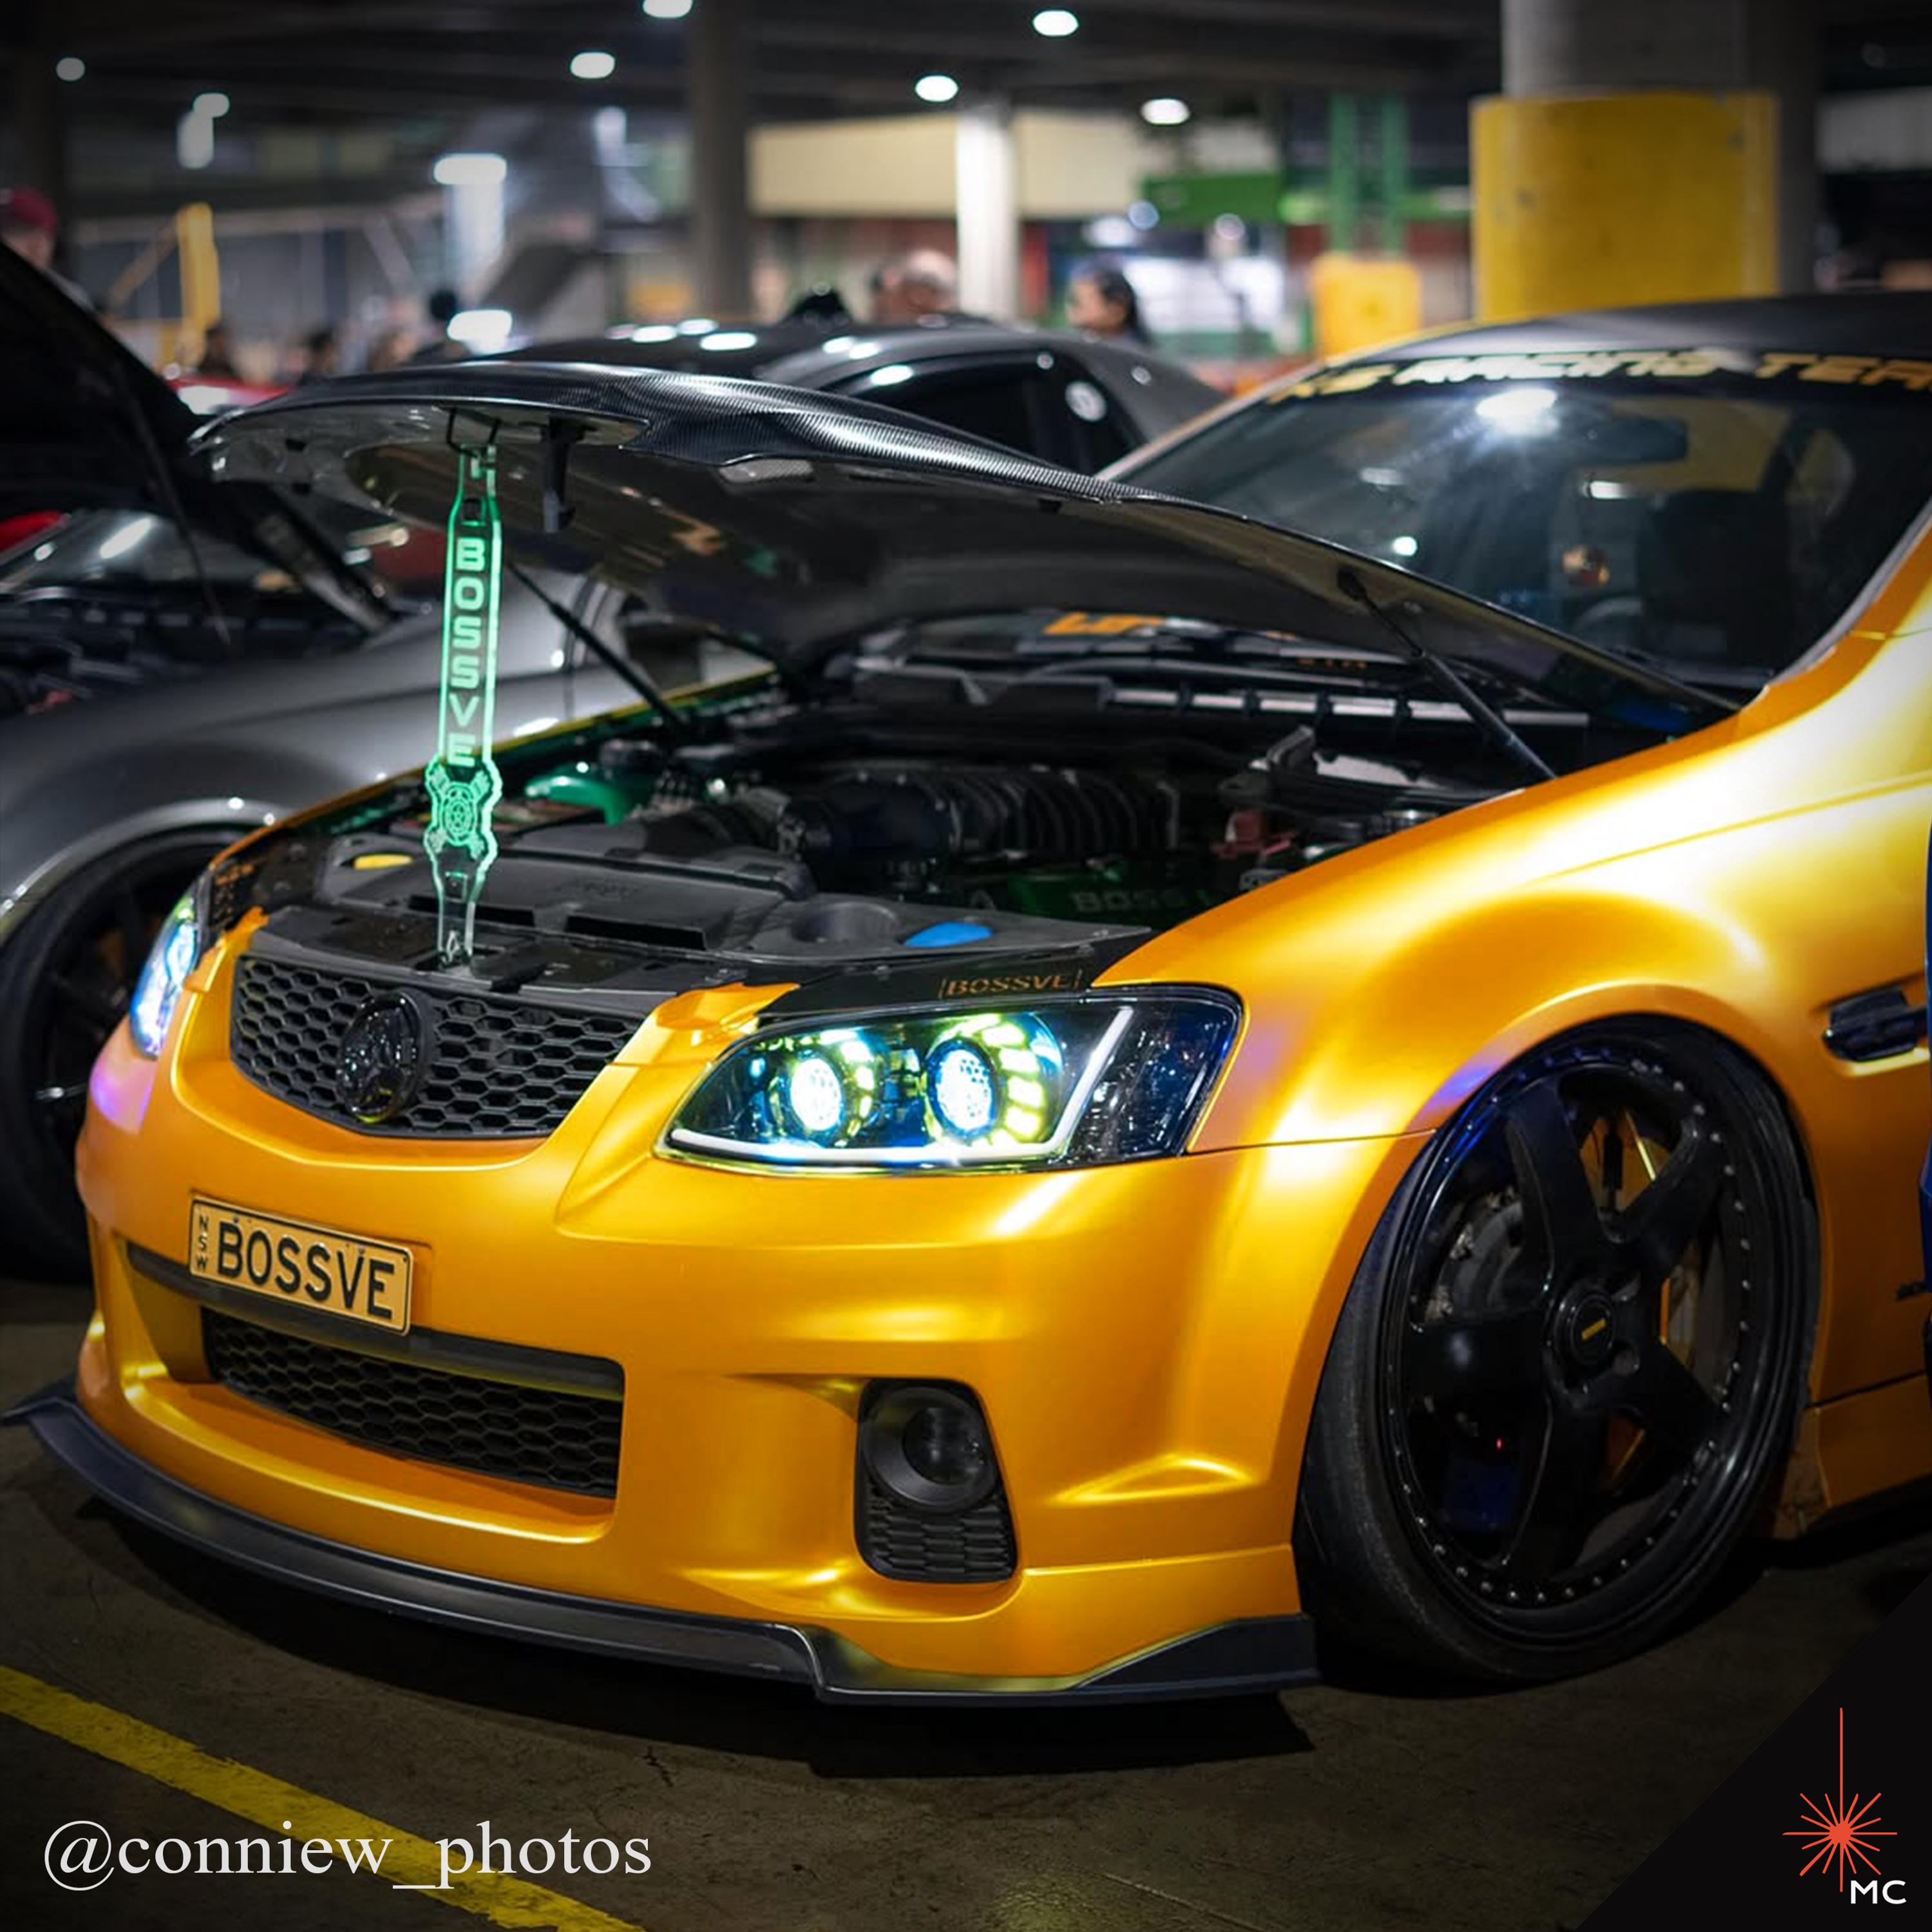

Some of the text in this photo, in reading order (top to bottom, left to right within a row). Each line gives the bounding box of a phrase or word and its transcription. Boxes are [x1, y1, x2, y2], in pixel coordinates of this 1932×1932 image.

[1755, 352, 1932, 391] TEA
[447, 536, 486, 767] BOSSVE
[196, 1215, 209, 1271] NSW
[217, 1221, 395, 1320] BOSSVE
